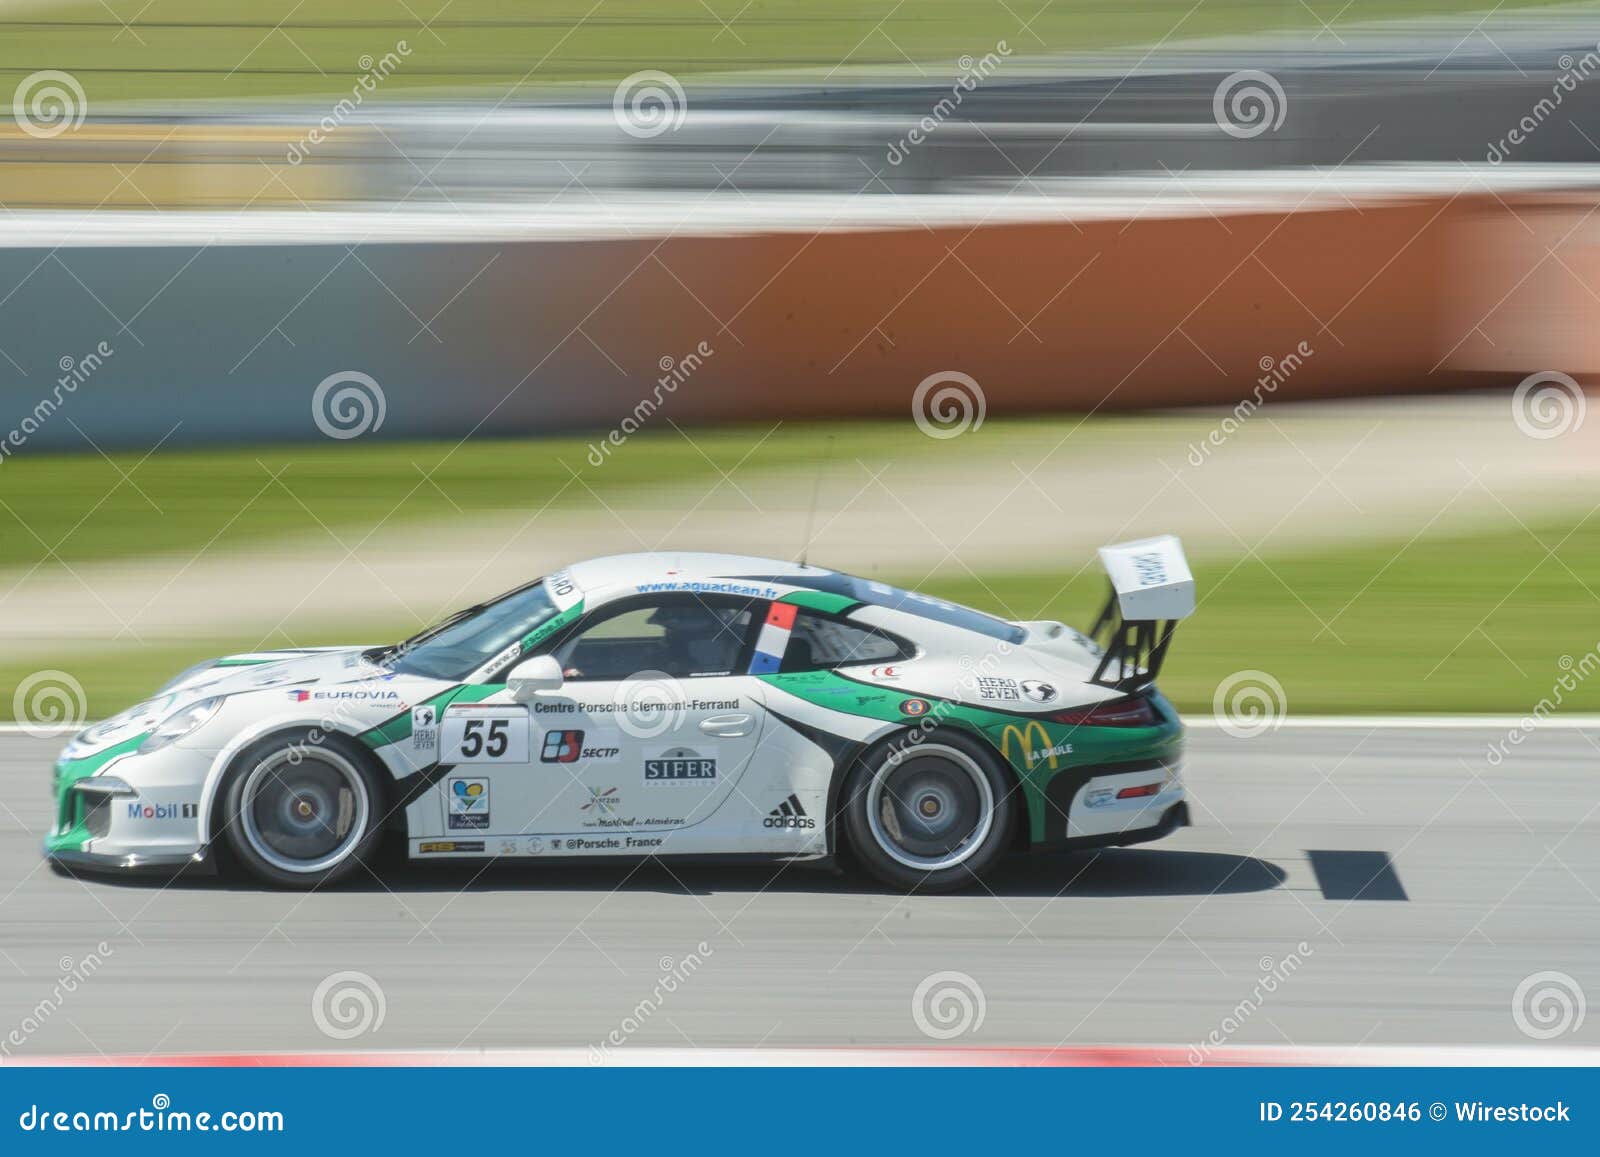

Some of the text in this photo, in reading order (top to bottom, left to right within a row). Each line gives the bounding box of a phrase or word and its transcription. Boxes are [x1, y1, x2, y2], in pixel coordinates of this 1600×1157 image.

[313, 691, 399, 699] EUROVIA
[980, 686, 1020, 700] SEVEN
[534, 699, 740, 713] Centre Porsche Clermont-Ferrand
[461, 719, 509, 758] 55
[582, 747, 619, 758] SECTP
[647, 761, 713, 778] SIFER
[128, 803, 198, 818] Mobil 1
[763, 816, 815, 828] adidas
[566, 836, 663, 849] @Porsche_France
